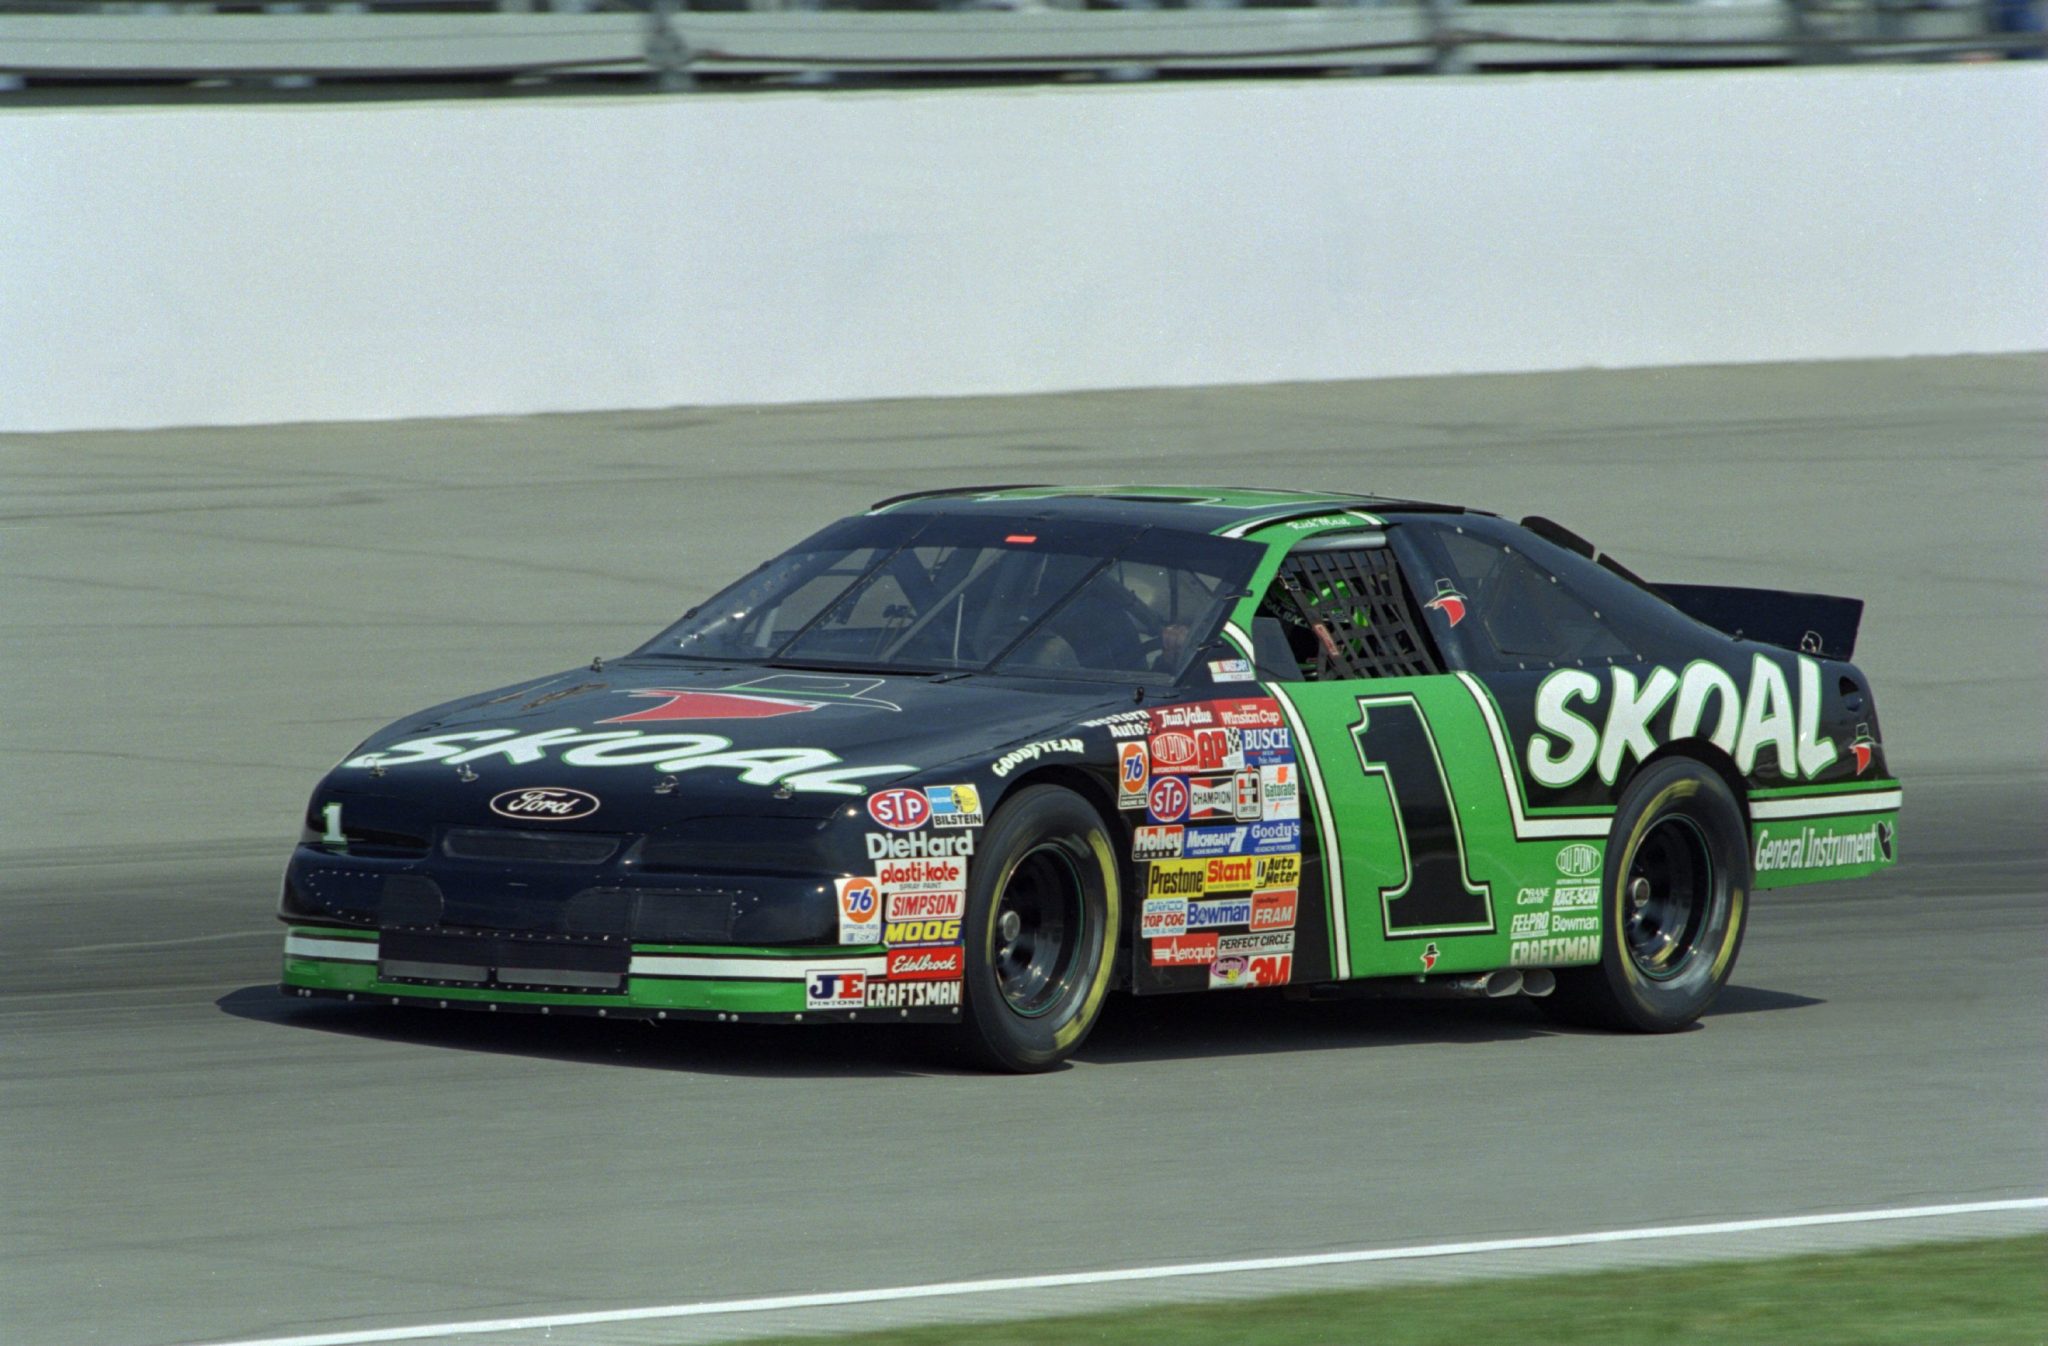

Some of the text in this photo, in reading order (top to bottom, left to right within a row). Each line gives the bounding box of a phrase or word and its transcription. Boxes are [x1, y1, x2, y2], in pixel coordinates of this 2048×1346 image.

[1221, 709, 1280, 725] Winston Cup
[1528, 653, 1837, 788] SKOAL
[1108, 724, 1145, 738] Auto
[1244, 728, 1290, 750] BUSCH
[340, 728, 922, 793] SKOAL
[991, 738, 1085, 778] GOODYEAR
[1198, 731, 1229, 769] AP
[1123, 751, 1145, 781] 76
[506, 790, 581, 814] Ford
[1153, 782, 1183, 815] STP
[1192, 790, 1232, 806] CHAMPION
[1264, 782, 1297, 798] Gatorade
[875, 791, 923, 822] STP
[1347, 691, 1497, 941] 1
[322, 802, 347, 845] 1
[933, 813, 982, 826] BILSTEIN
[865, 829, 975, 859] DieHard
[1134, 828, 1182, 857] Holley
[1252, 822, 1300, 843] Goody's
[1755, 823, 1877, 872] General Instrument
[880, 861, 960, 886] plasti-kote
[1207, 858, 1252, 882] Stant
[1267, 858, 1295, 871] Auto
[1150, 865, 1204, 895] Prestone
[1265, 871, 1299, 884] Meter
[848, 887, 874, 914] 76
[892, 894, 959, 917] SIMPSON
[1144, 911, 1186, 928] TOP COG
[1187, 903, 1250, 926] Bowman
[1254, 906, 1293, 925] FRAM
[1552, 914, 1599, 932] Bowman
[884, 920, 961, 943] MOOG
[1219, 933, 1291, 949] PERFECT CIRCLE
[1168, 937, 1216, 963] Aeroquip
[1511, 934, 1600, 967] CRAFTSMAN
[892, 954, 957, 974] Edelbrock
[1250, 955, 1292, 987] 3M
[809, 974, 865, 999] JE
[867, 981, 961, 1007] CRAFTSMAN
